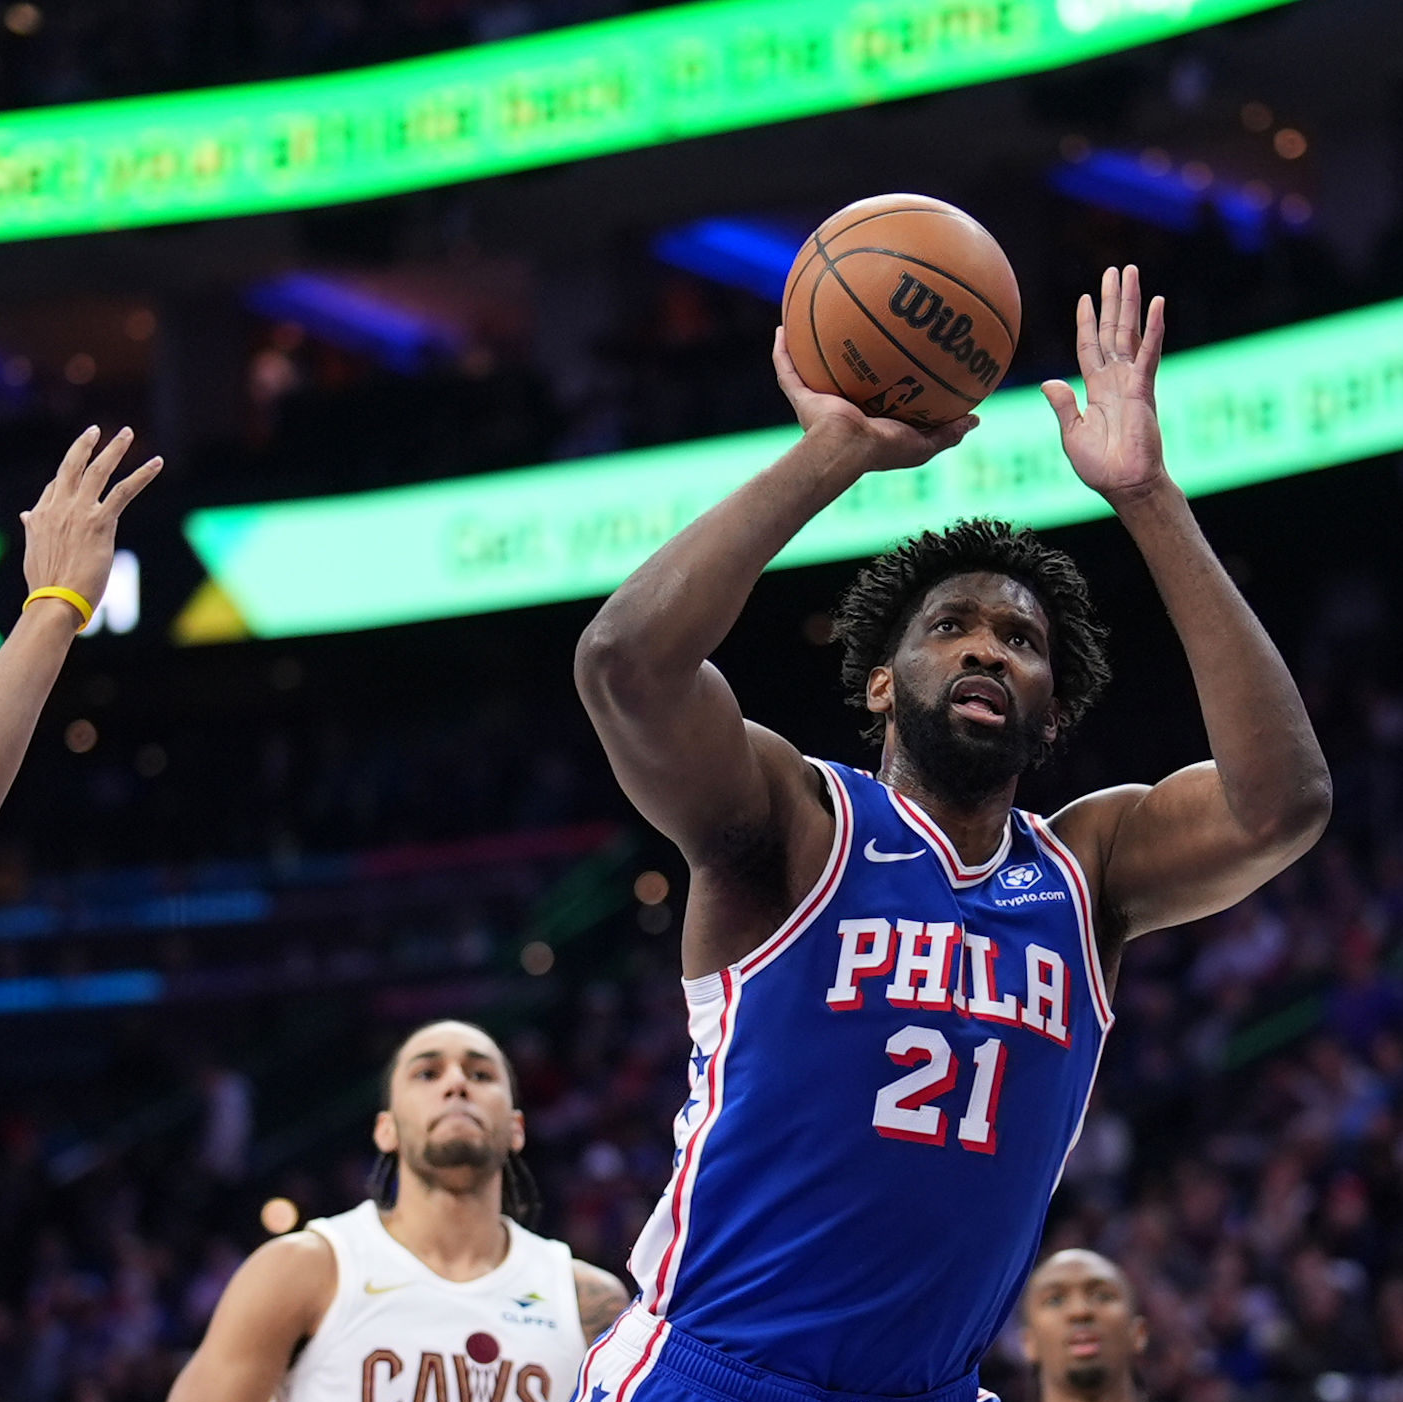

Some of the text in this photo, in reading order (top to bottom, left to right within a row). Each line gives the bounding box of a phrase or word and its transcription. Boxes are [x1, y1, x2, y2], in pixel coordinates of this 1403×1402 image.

[888, 270, 1001, 388] Wilson
[995, 890, 1066, 908] crypto.com
[825, 917, 1071, 1048] PHILA
[872, 1025, 1007, 1155] 21
